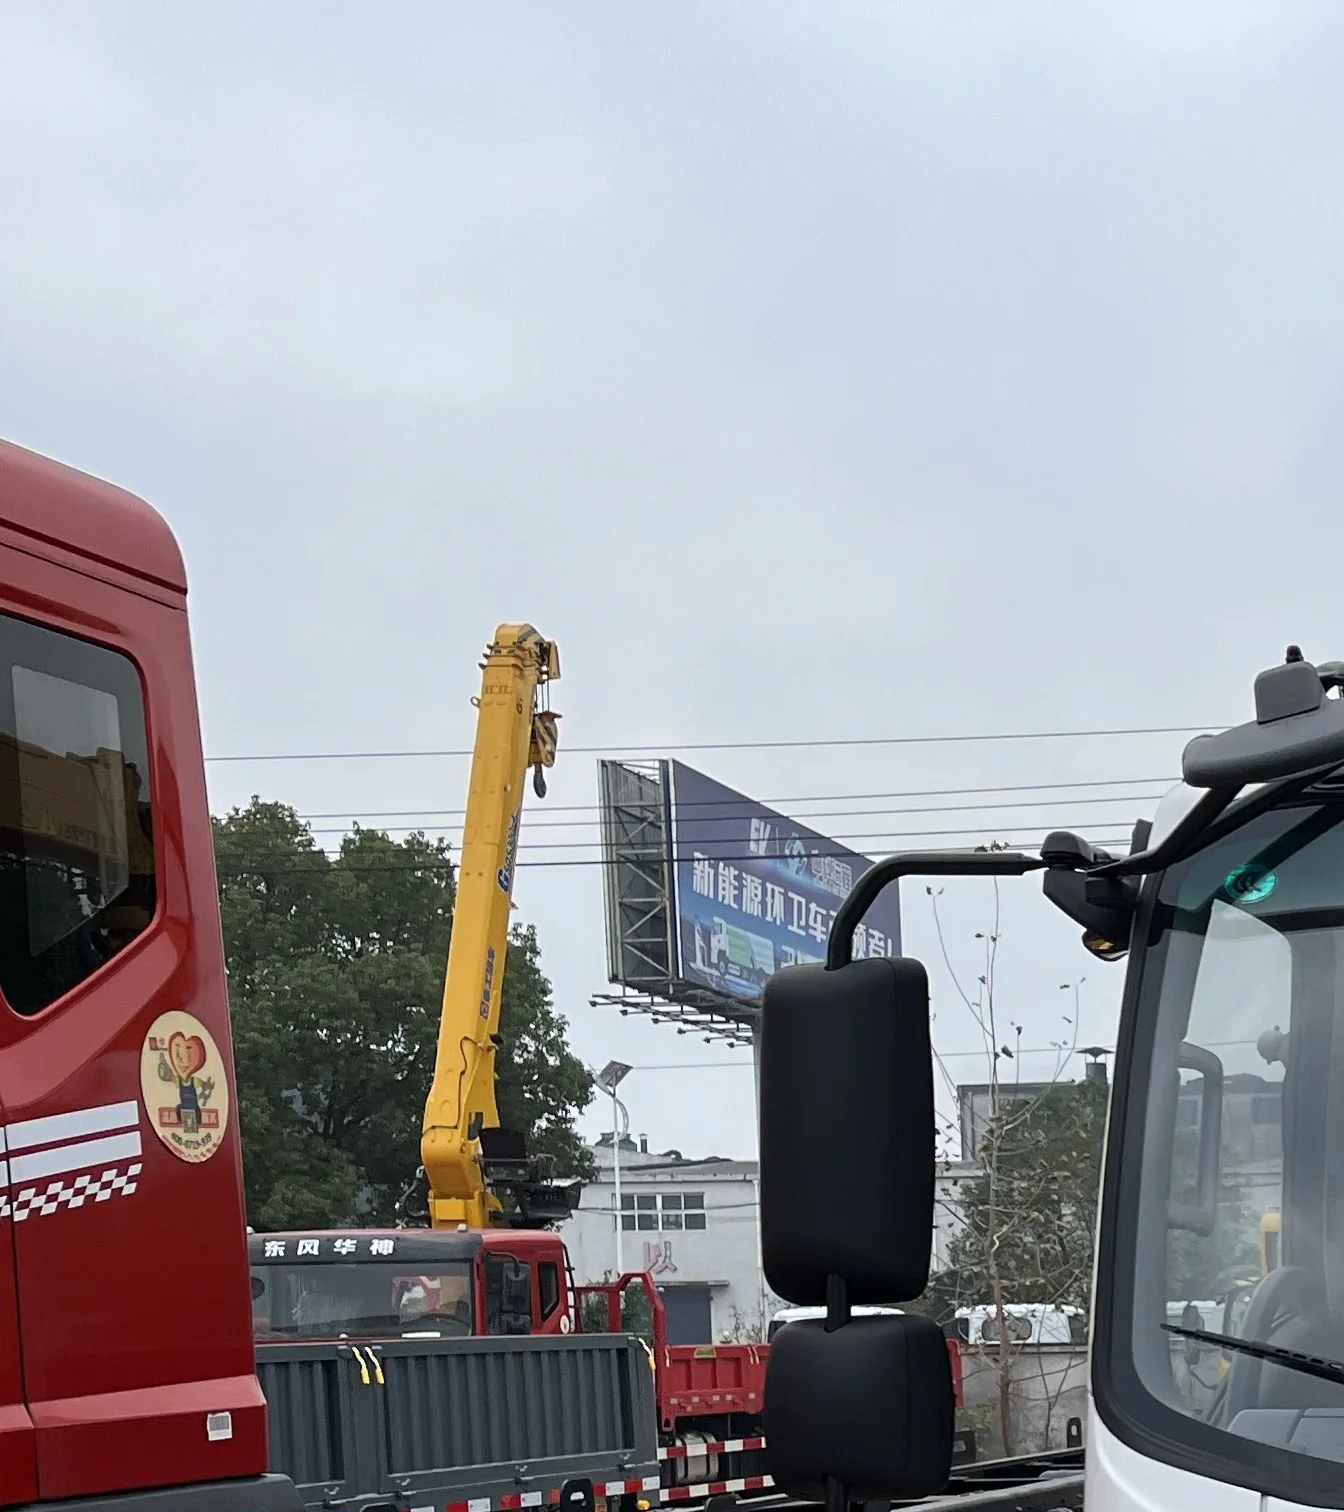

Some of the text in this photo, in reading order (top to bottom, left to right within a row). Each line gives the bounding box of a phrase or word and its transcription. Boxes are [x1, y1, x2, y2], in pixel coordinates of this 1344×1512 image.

[692, 851, 892, 959] 新能源环卫车领者!
[264, 1238, 395, 1258] 东风华神
